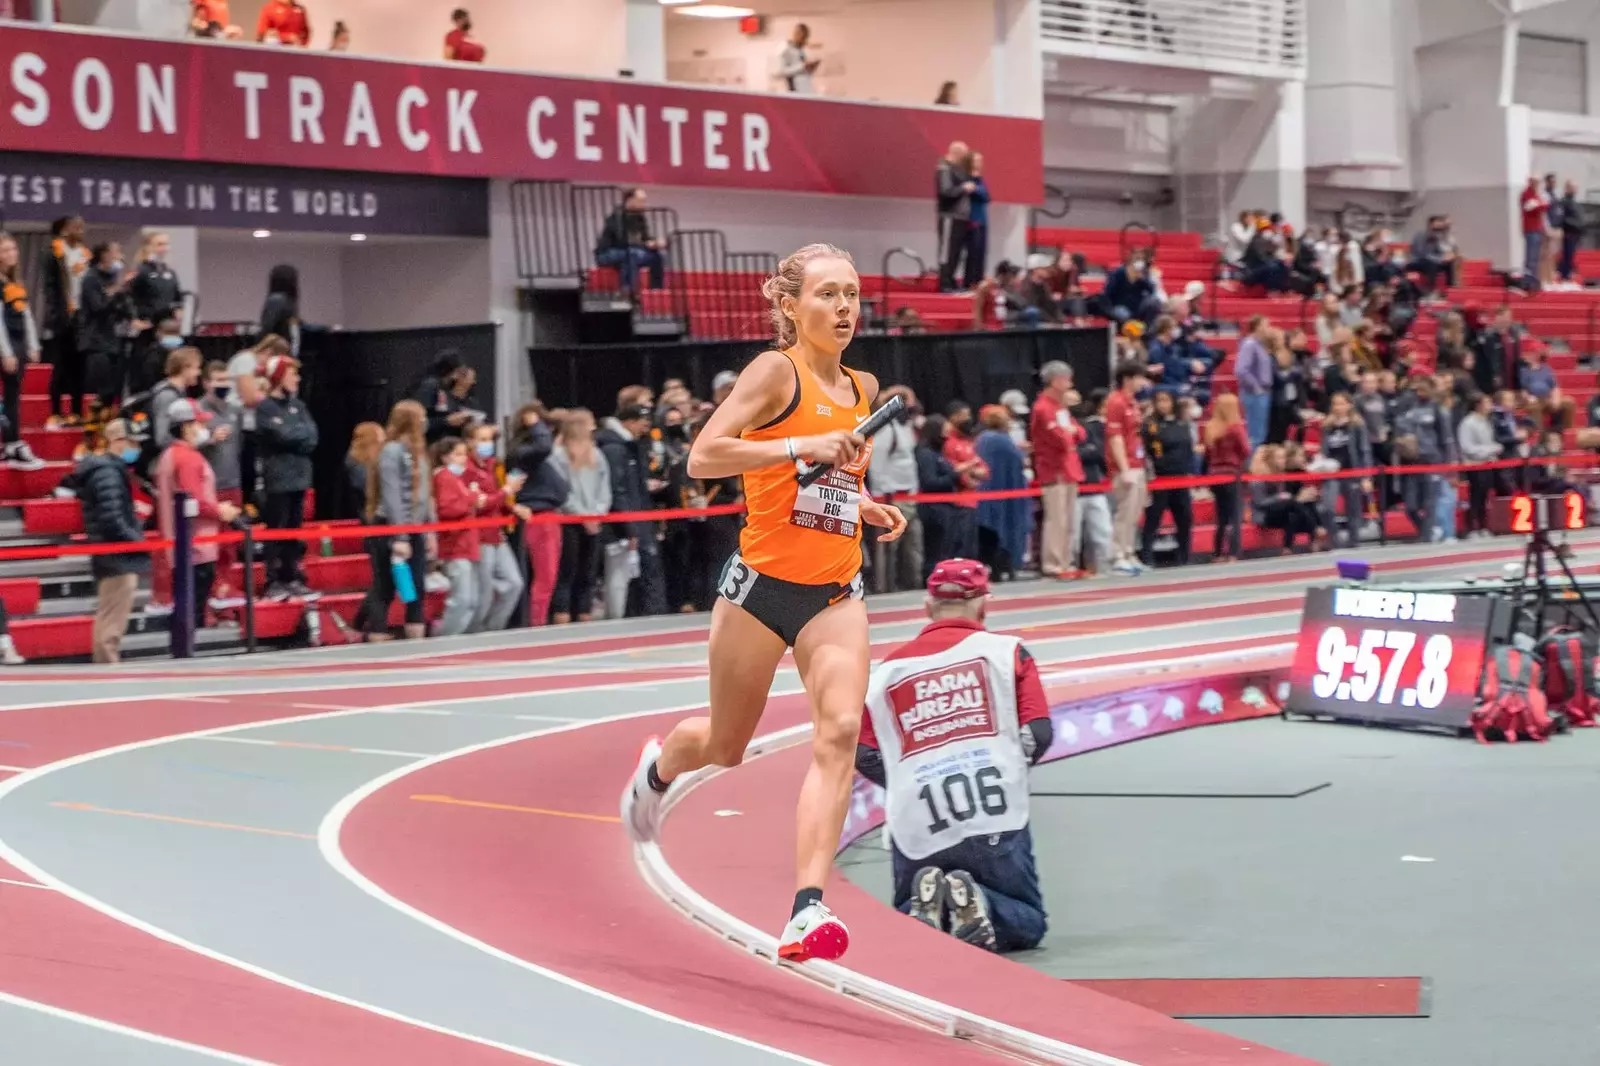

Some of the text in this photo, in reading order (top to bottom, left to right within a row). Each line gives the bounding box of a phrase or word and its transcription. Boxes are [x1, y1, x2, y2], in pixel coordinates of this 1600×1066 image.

[11, 52, 771, 172] SON TRACK CENTER
[80, 178, 173, 208] TRACK
[187, 184, 215, 211] IN
[229, 186, 279, 213] THE
[292, 190, 378, 217] WORLD
[818, 487, 848, 504] TAYLOR
[823, 502, 841, 516] ROE
[1511, 494, 1534, 533] 2
[1565, 492, 1584, 530] 2
[724, 562, 749, 600] 3
[915, 670, 980, 700] FARM
[1312, 626, 1453, 709] 9:57.8
[913, 714, 989, 742] INSURANCE
[918, 766, 1008, 834] 106
